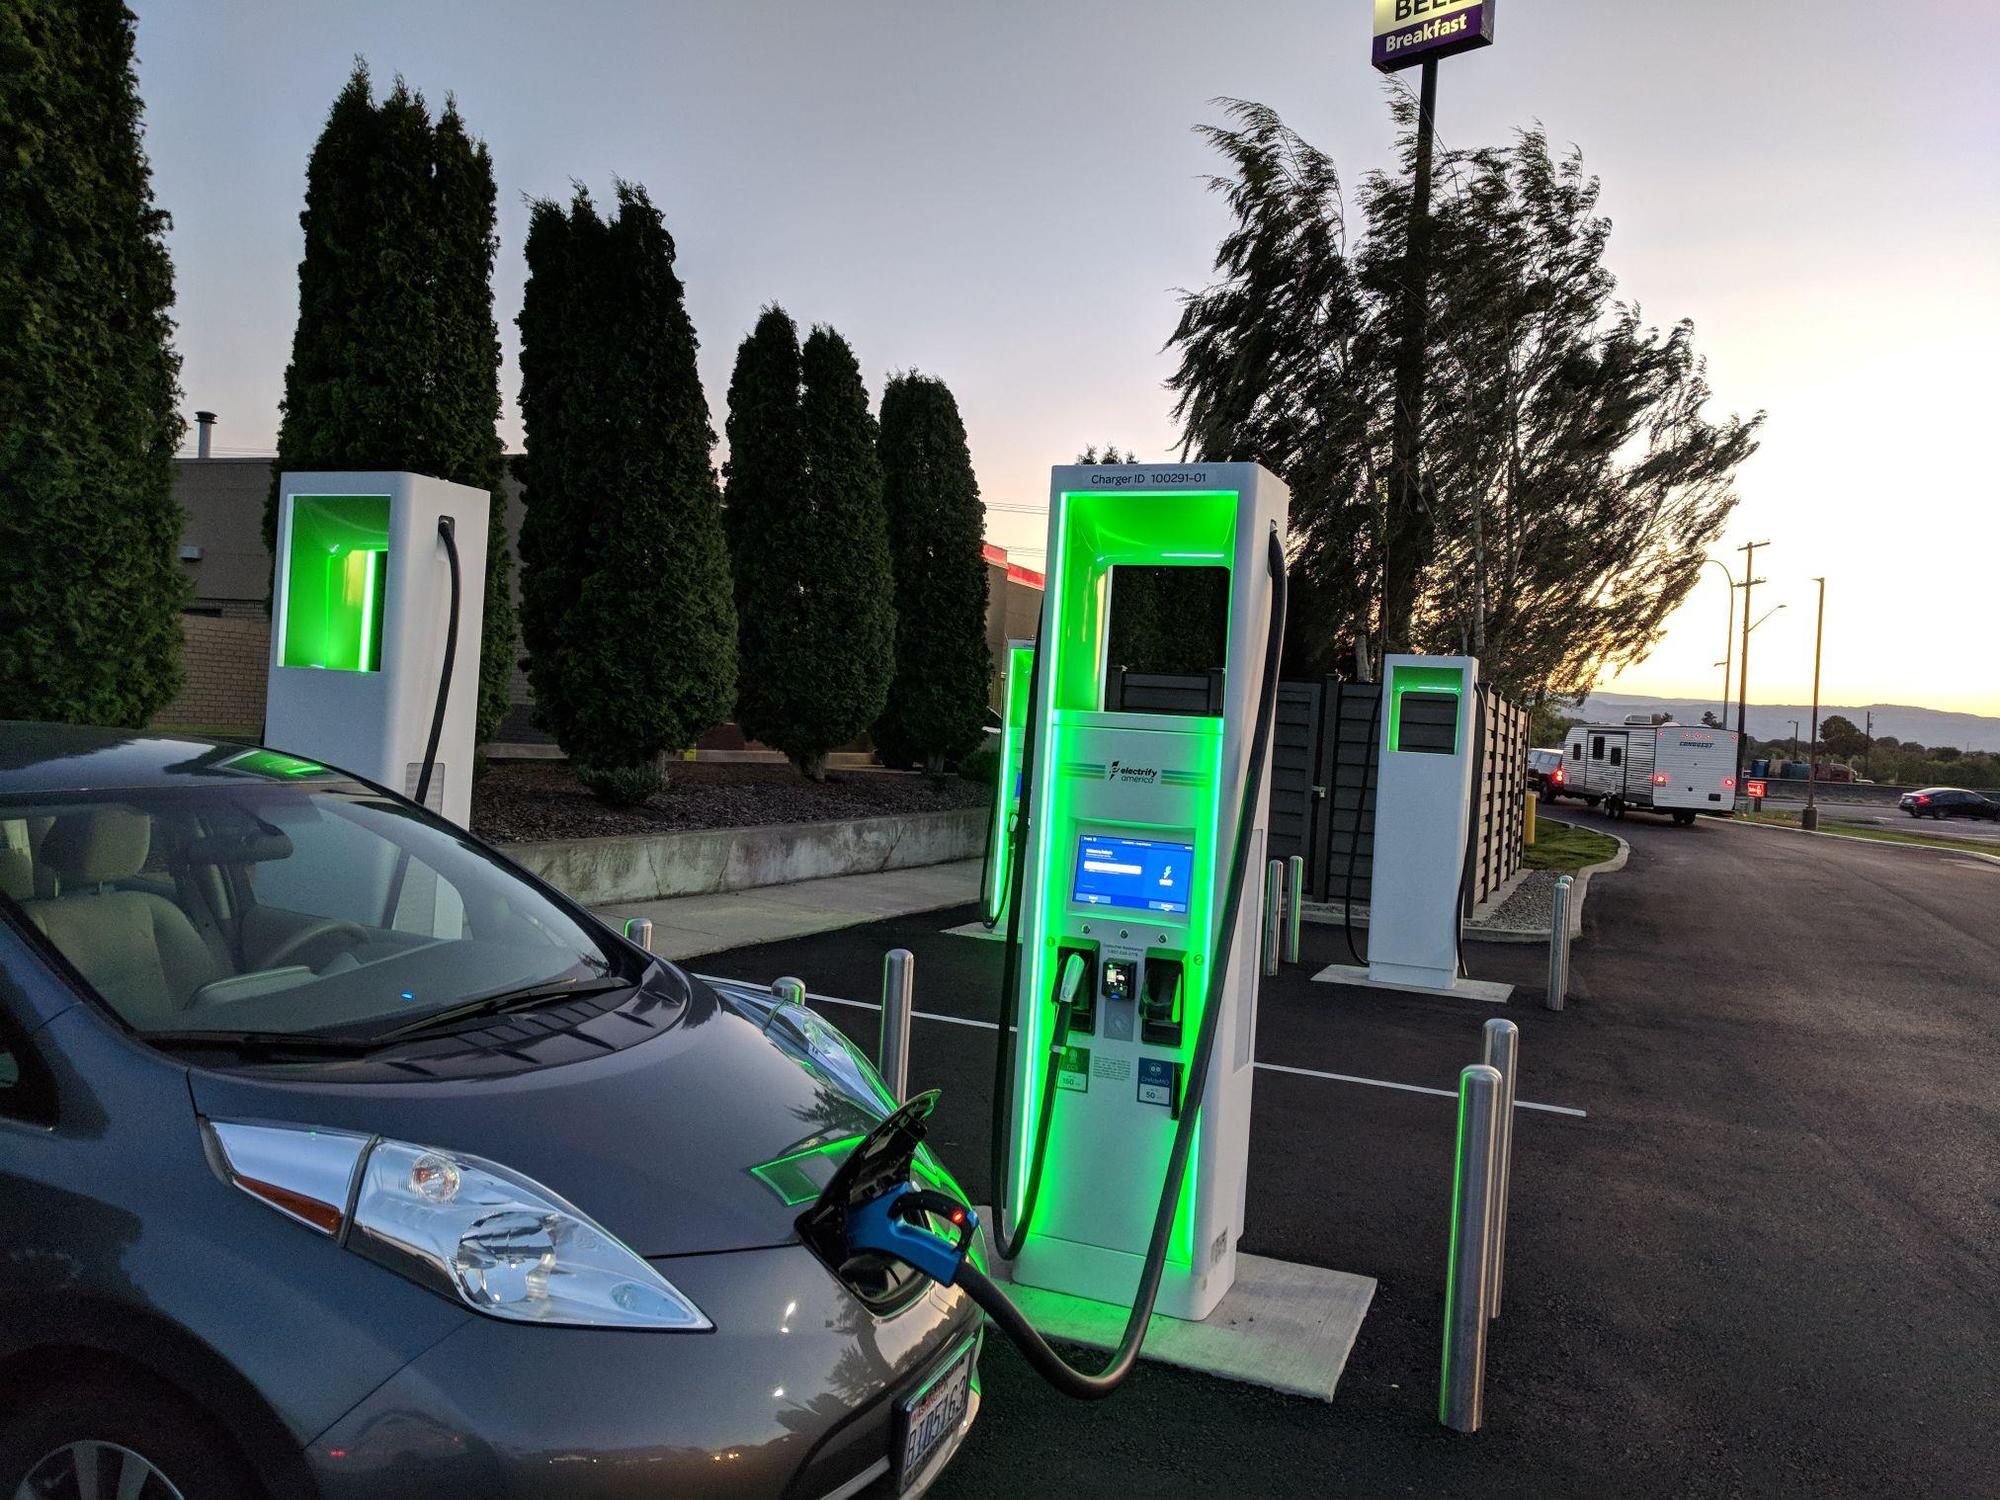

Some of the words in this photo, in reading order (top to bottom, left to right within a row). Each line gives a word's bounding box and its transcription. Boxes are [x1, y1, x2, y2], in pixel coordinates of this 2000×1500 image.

[1385, 13, 1467, 52] Breakfast
[1091, 474, 1132, 485] Charger
[1134, 474, 1145, 483] ID
[1151, 473, 1206, 483] 100291-01
[1120, 767, 1157, 777] electrify
[1121, 775, 1154, 784] america
[1145, 1091, 1155, 1099] 50
